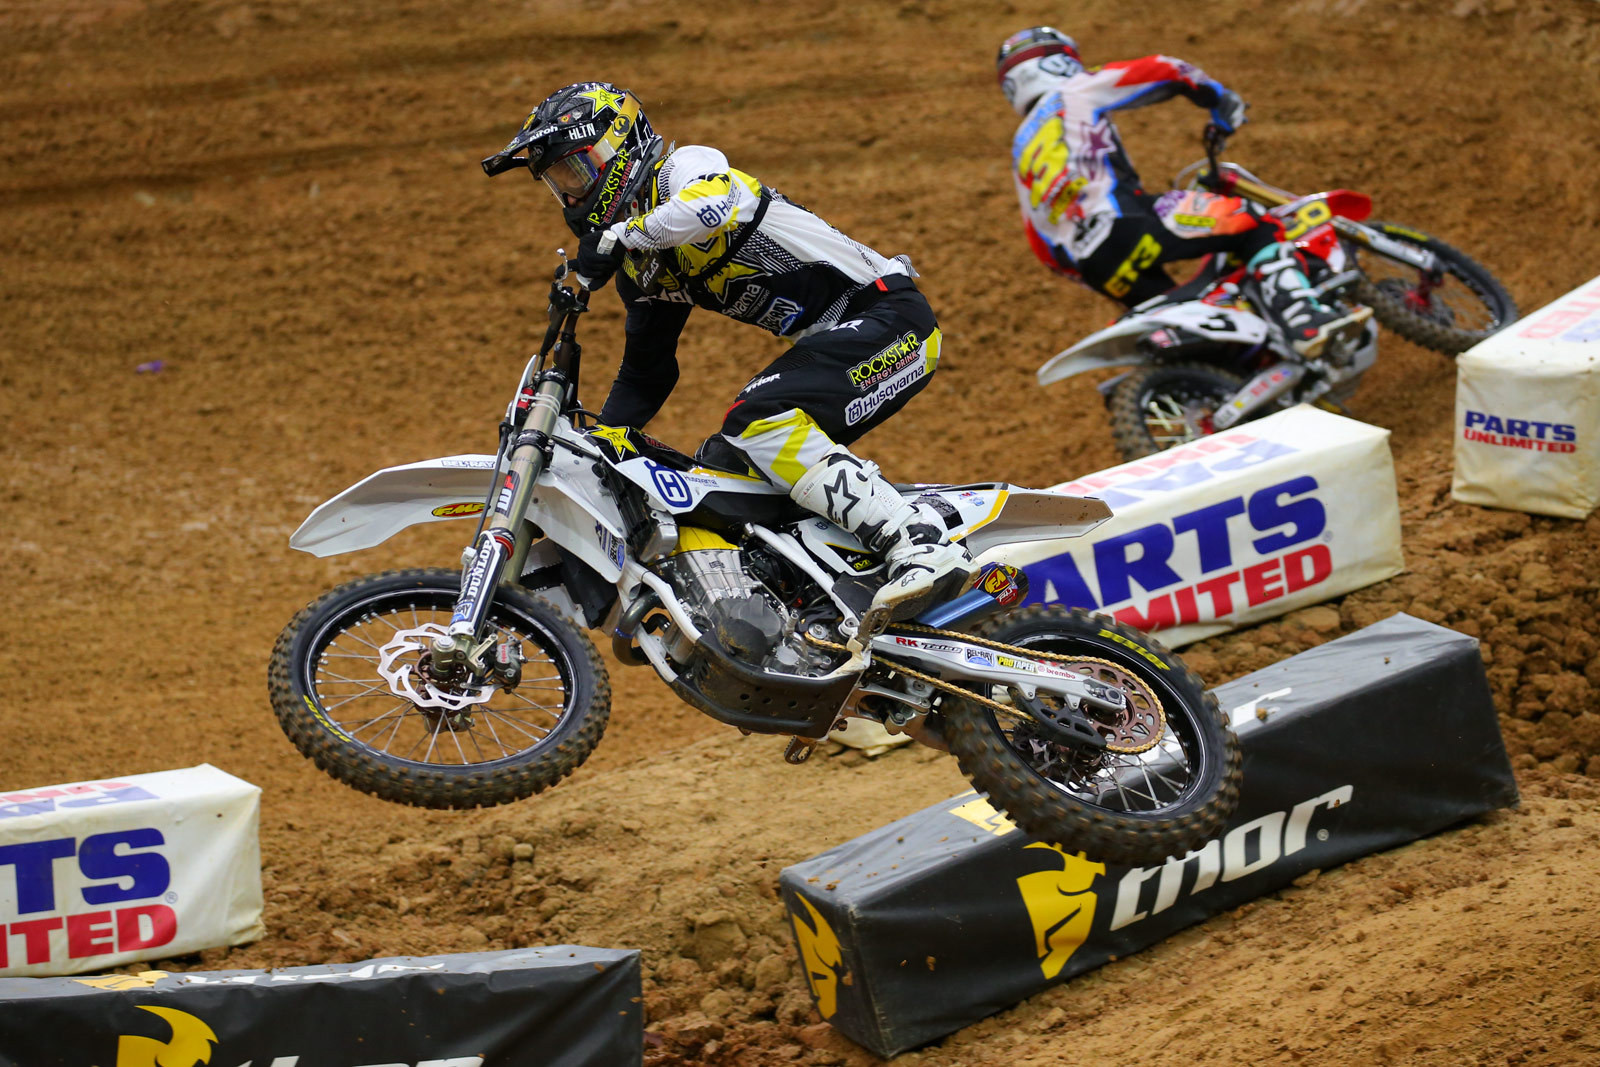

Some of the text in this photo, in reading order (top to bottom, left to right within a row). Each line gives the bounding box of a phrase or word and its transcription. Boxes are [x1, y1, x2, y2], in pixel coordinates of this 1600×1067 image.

[569, 123, 596, 140] HLTN
[603, 160, 634, 223] ENERGY DRINK
[860, 351, 918, 389] ENERGY DRINK
[864, 365, 924, 413] Husqvarna
[1464, 428, 1576, 454] UNLIMITED
[1465, 410, 1576, 442] PARTS
[467, 540, 493, 598] DUNLOP
[1113, 544, 1333, 633] MITED
[895, 636, 919, 648] RK
[1046, 667, 1076, 680] brembo
